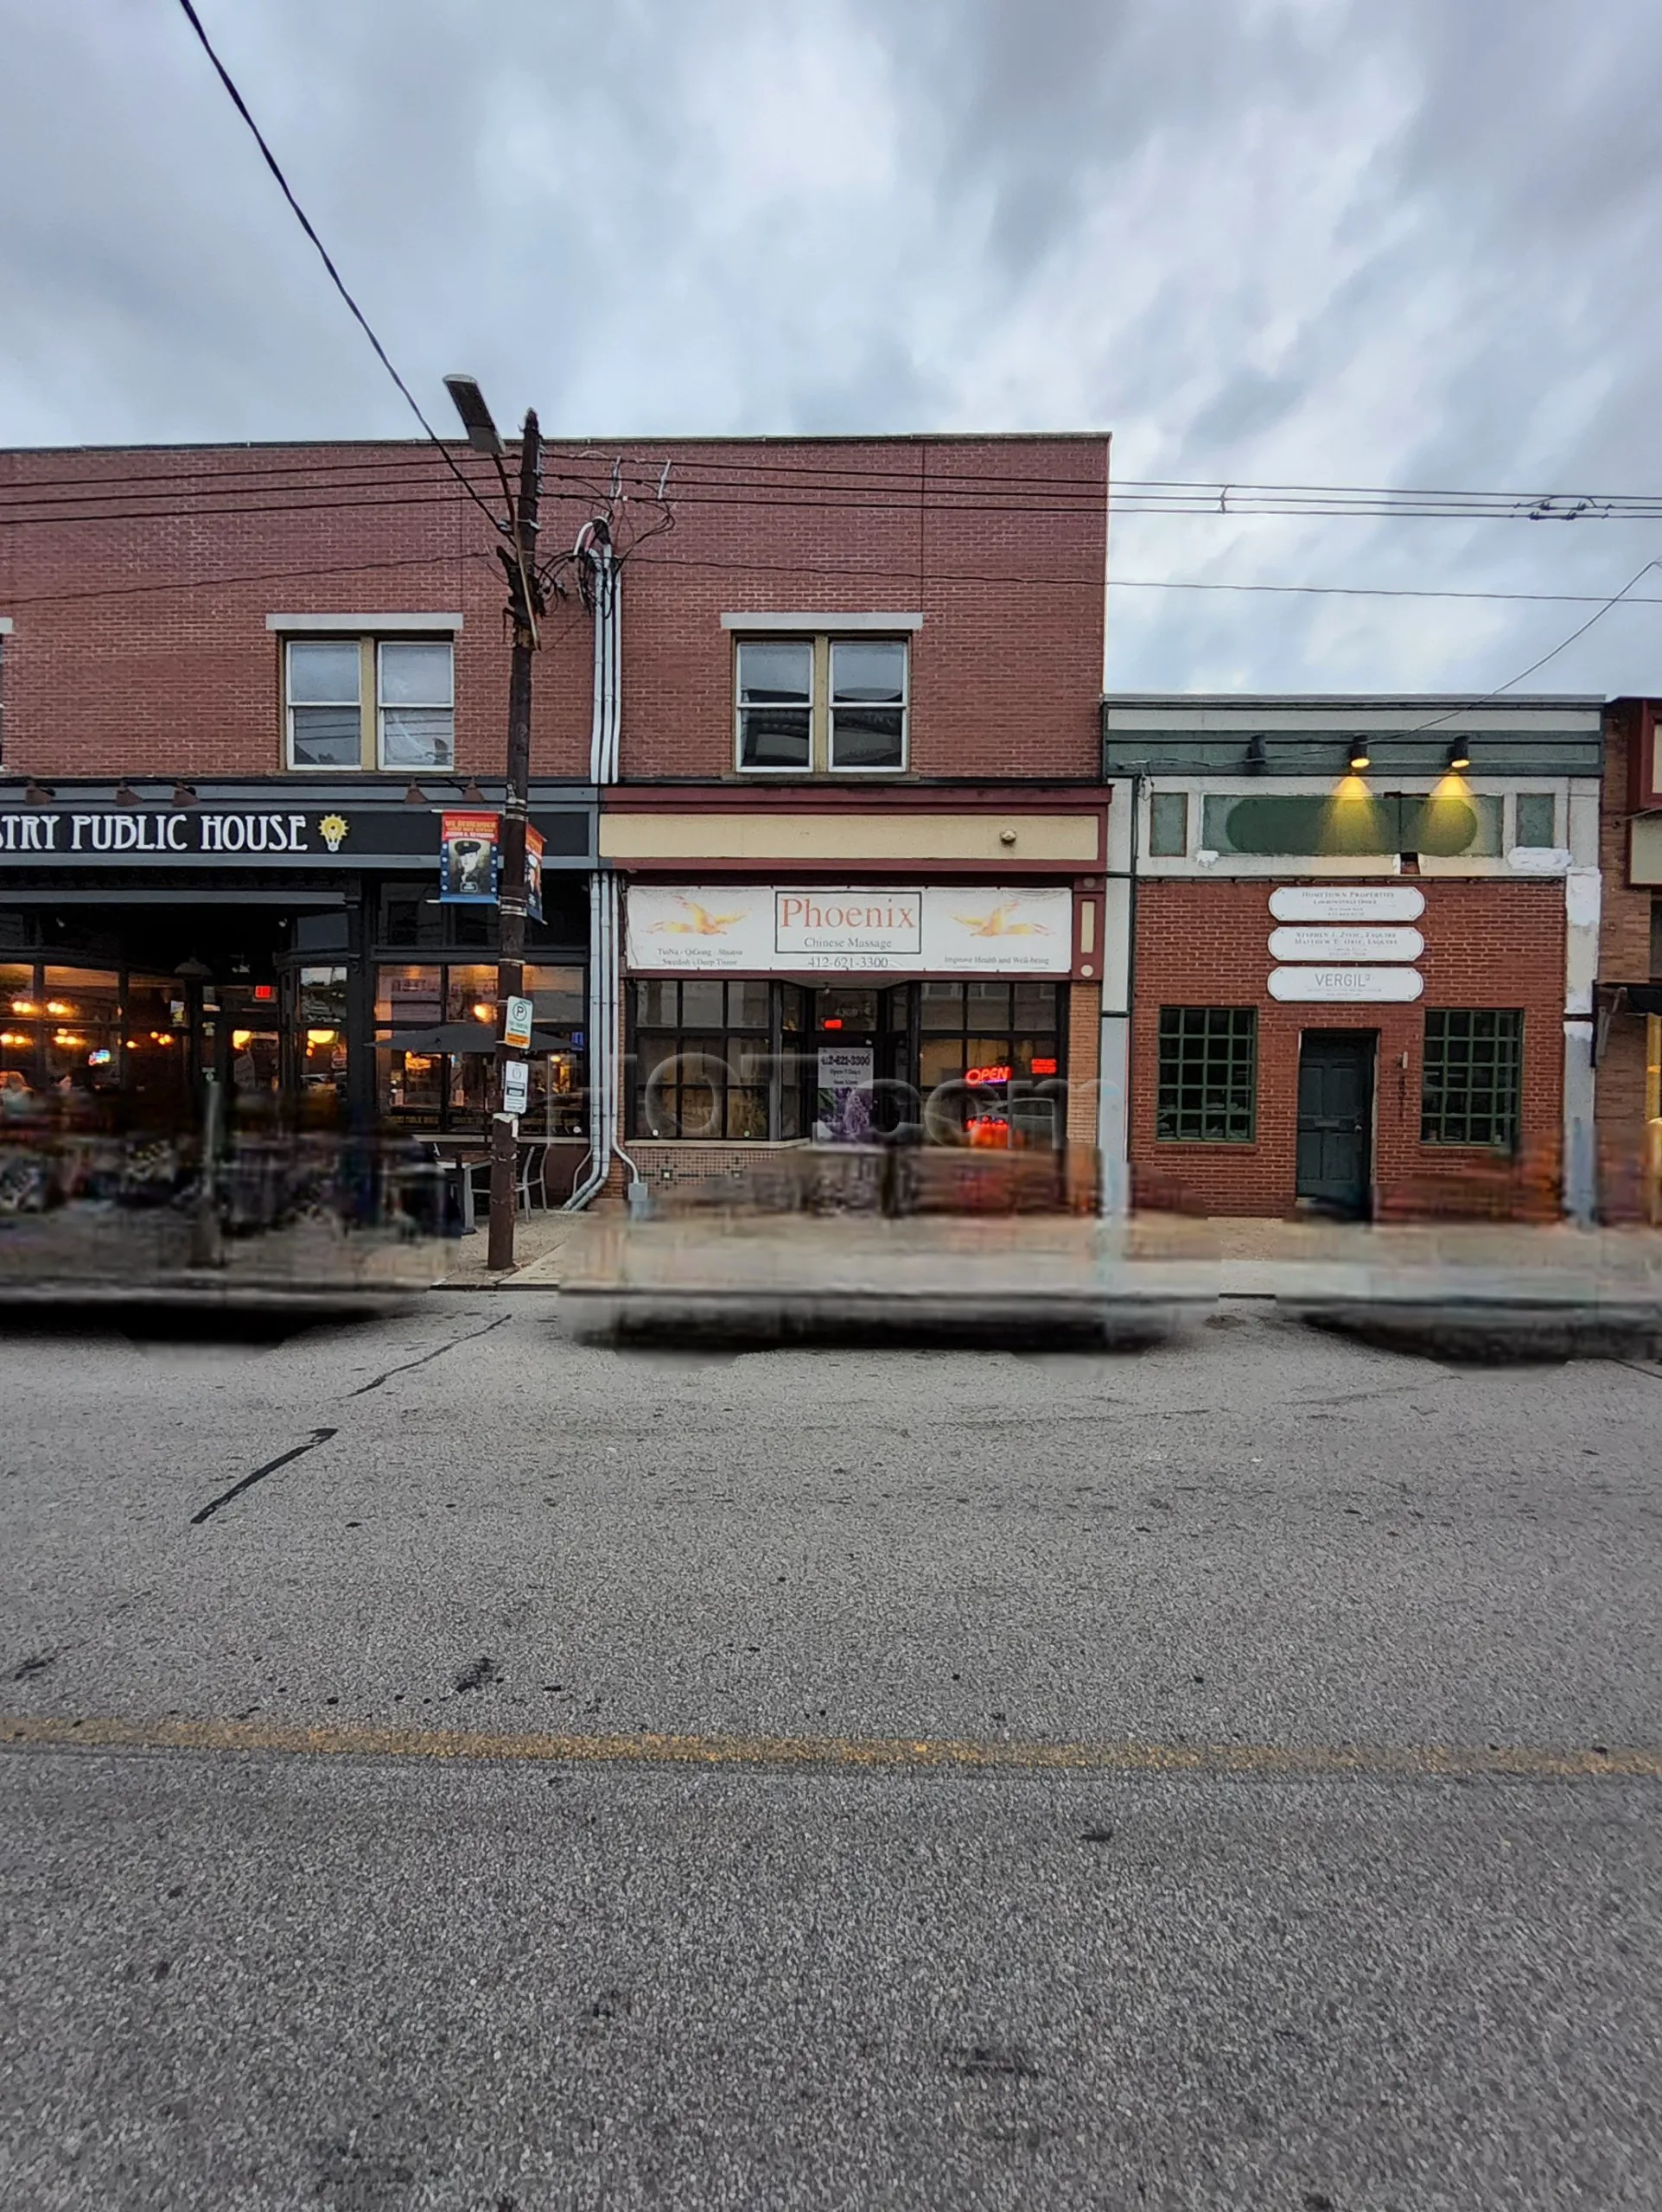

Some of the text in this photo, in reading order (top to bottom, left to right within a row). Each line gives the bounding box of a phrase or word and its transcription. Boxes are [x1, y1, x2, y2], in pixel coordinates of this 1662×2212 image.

[0, 815, 308, 851] TRY PUBLIC HOUSE
[780, 898, 916, 928] Phoenix
[805, 937, 892, 950] Chinese Massage
[807, 957, 888, 968] 412-621-3300
[944, 956, 973, 964] Improve
[1013, 956, 1050, 965] Well-being
[1315, 973, 1366, 987] VERGIL
[965, 1066, 1010, 1085] OPEN
